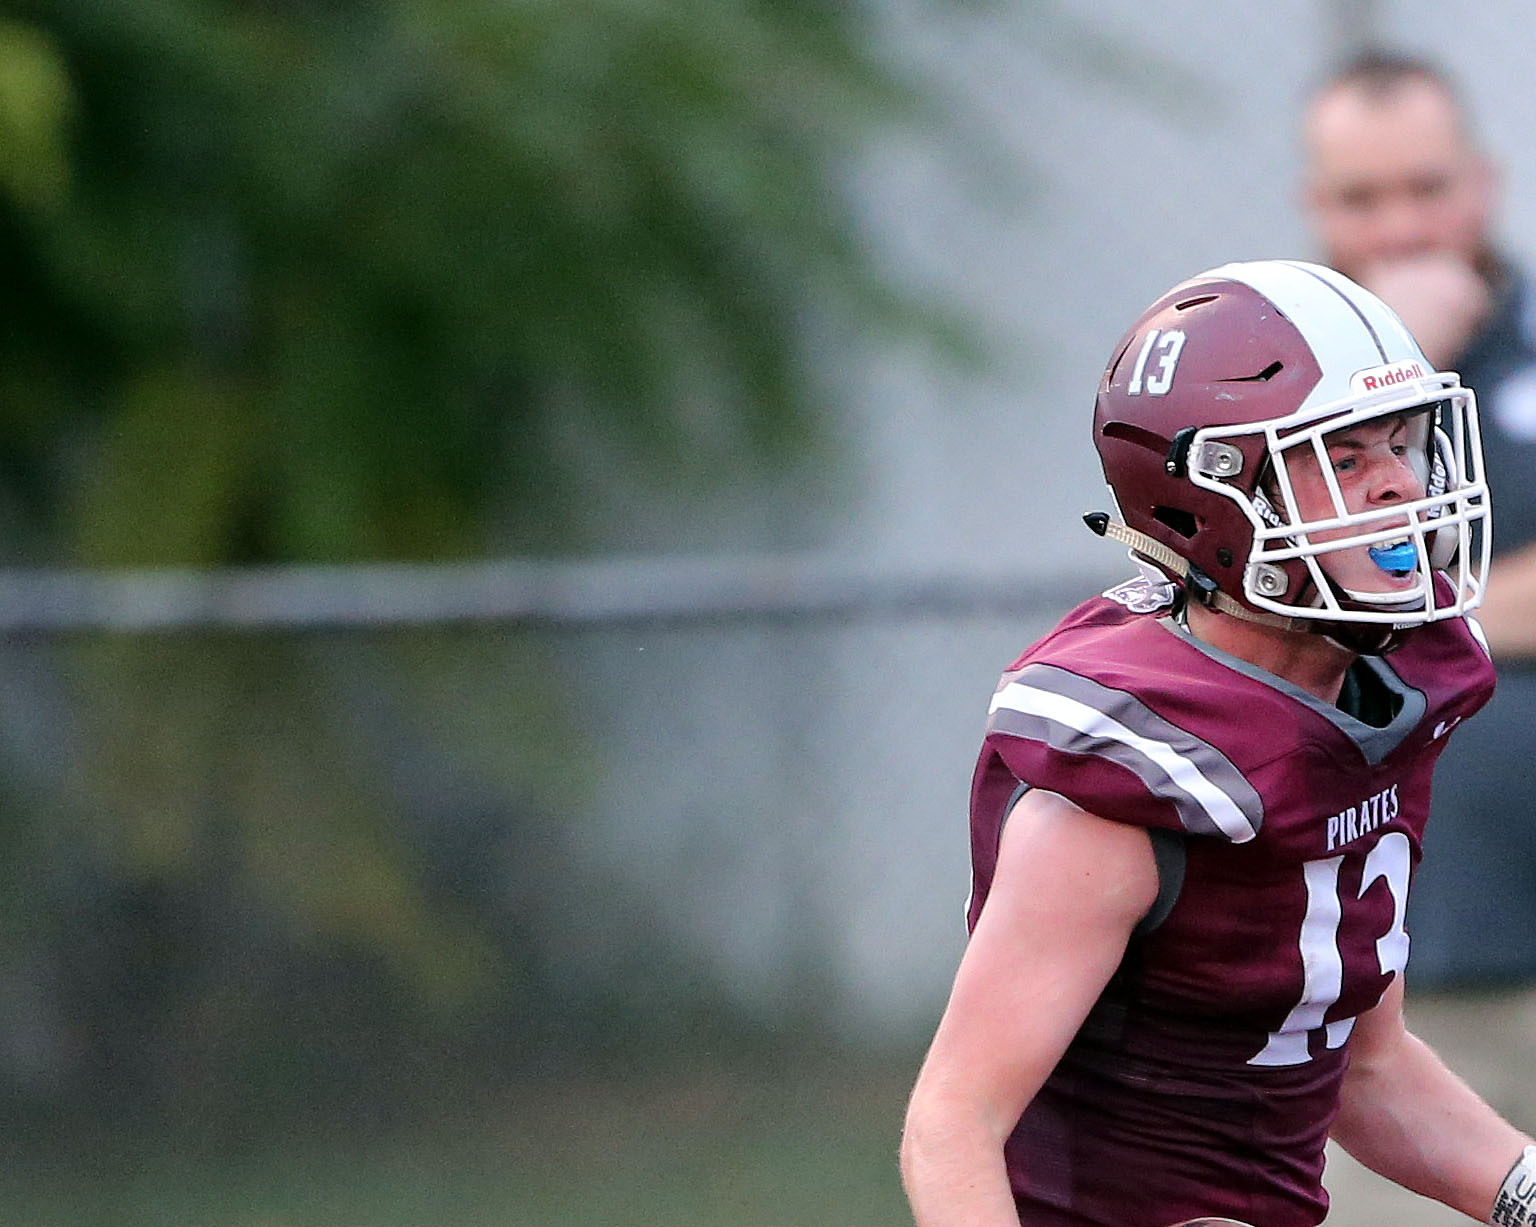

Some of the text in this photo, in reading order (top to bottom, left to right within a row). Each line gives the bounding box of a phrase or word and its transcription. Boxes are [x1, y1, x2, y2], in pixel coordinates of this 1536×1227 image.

[1127, 328, 1187, 397] 13
[1362, 363, 1424, 391] Riddell
[1326, 783, 1399, 852] PIRATES
[1245, 831, 1411, 1067] 13
